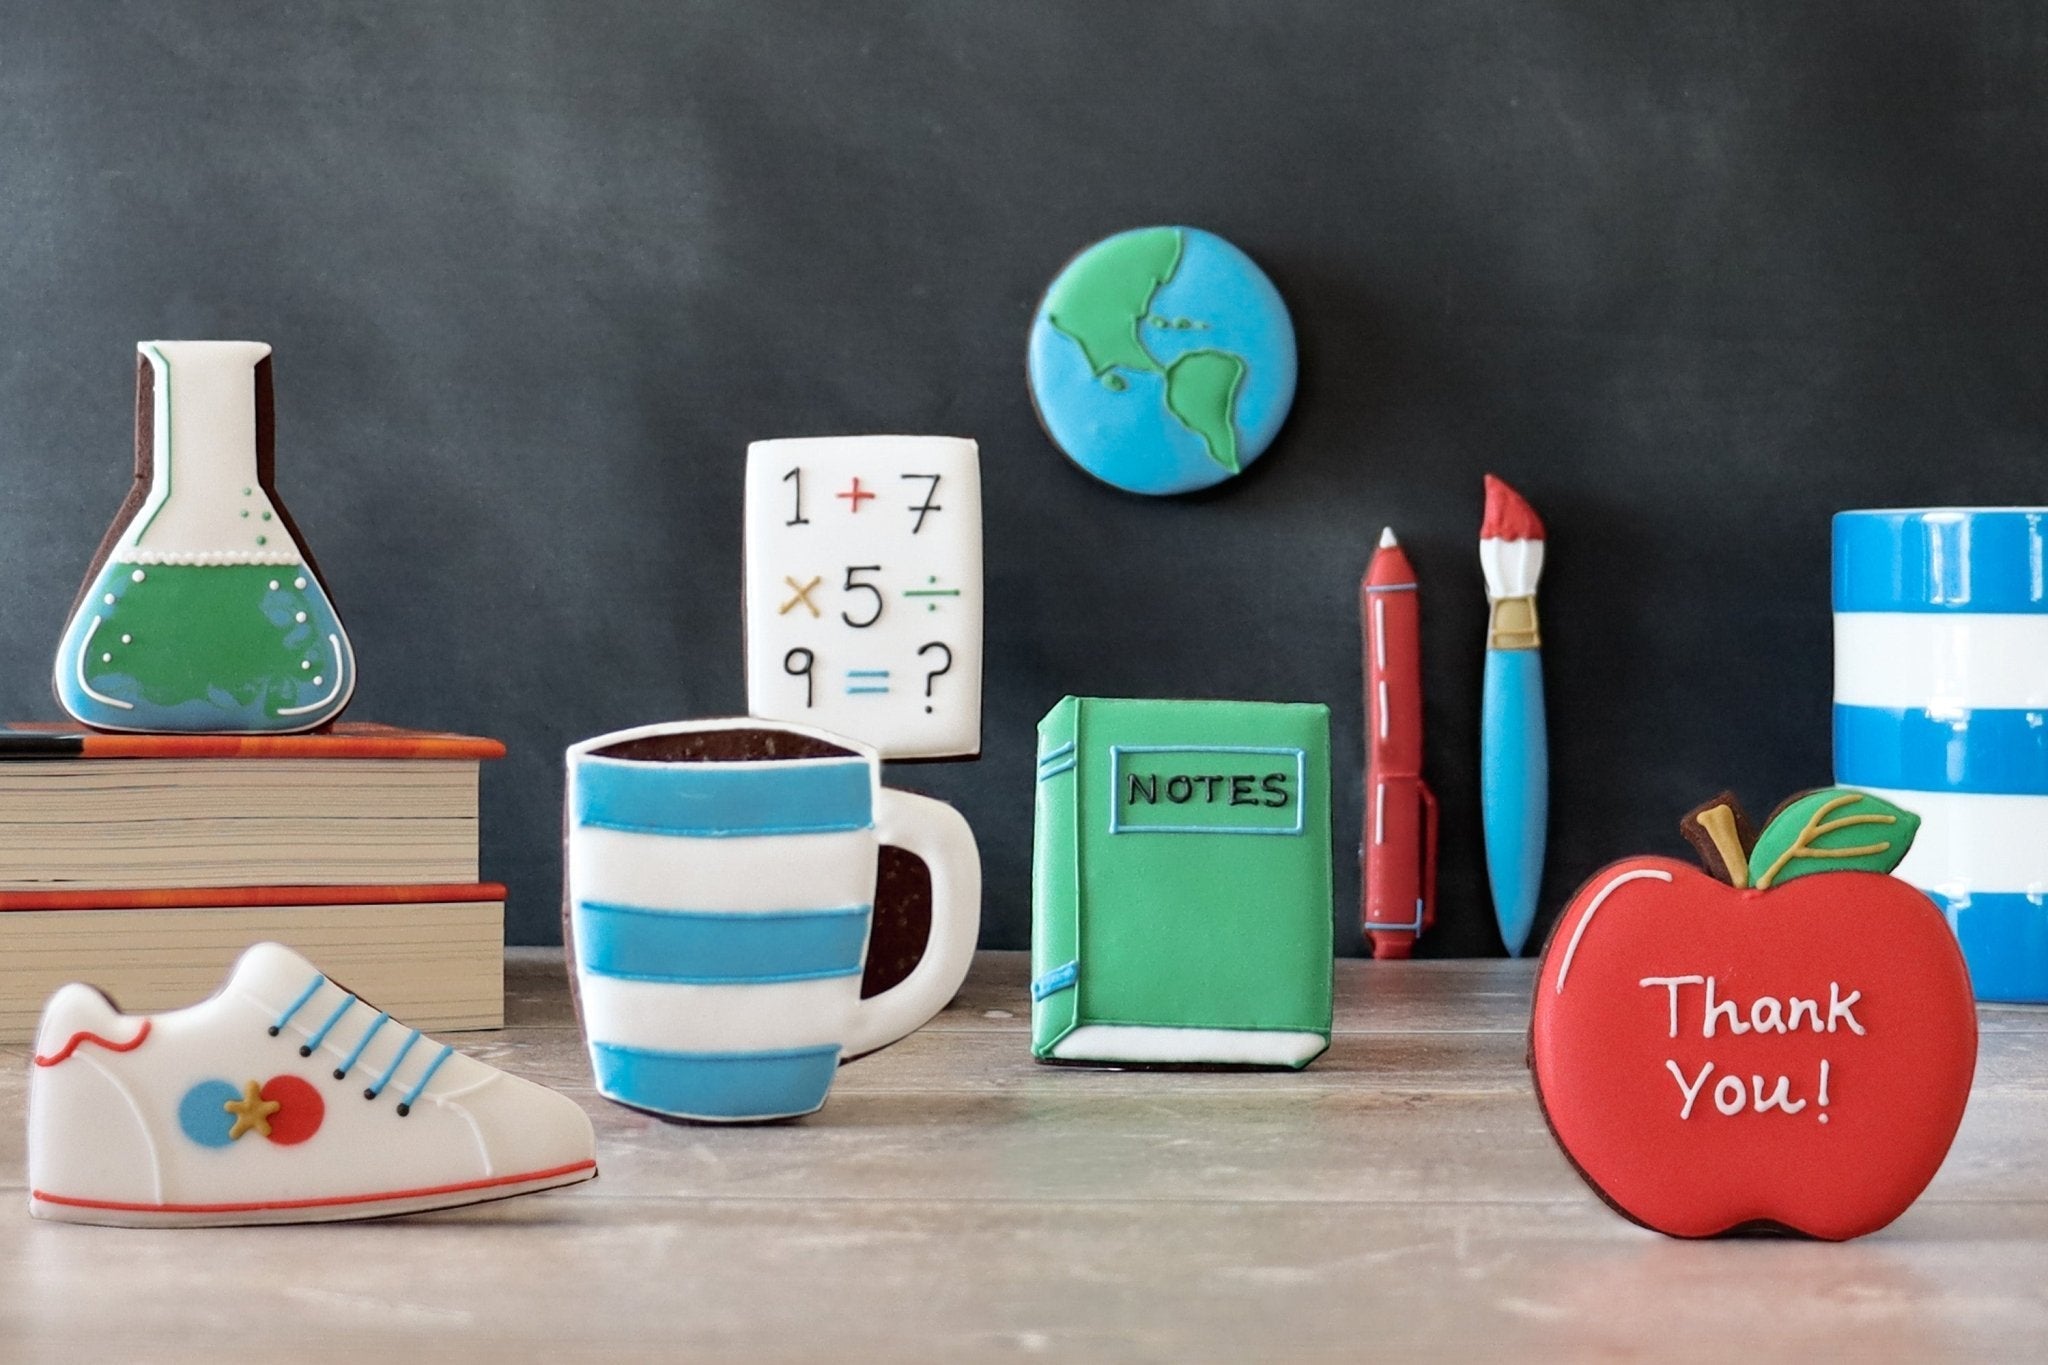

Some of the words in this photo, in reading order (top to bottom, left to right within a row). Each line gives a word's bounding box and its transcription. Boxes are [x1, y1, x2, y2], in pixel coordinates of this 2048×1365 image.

[783, 467, 810, 527] 1
[837, 476, 876, 513] +
[901, 474, 942, 535] 7
[841, 564, 884, 629] 5
[783, 646, 816, 709] 9
[845, 669, 890, 695] =
[916, 640, 953, 715] ?
[1126, 772, 1291, 809] NOTES
[1639, 974, 1867, 1039] Thank
[1664, 1058, 1831, 1125] You!
